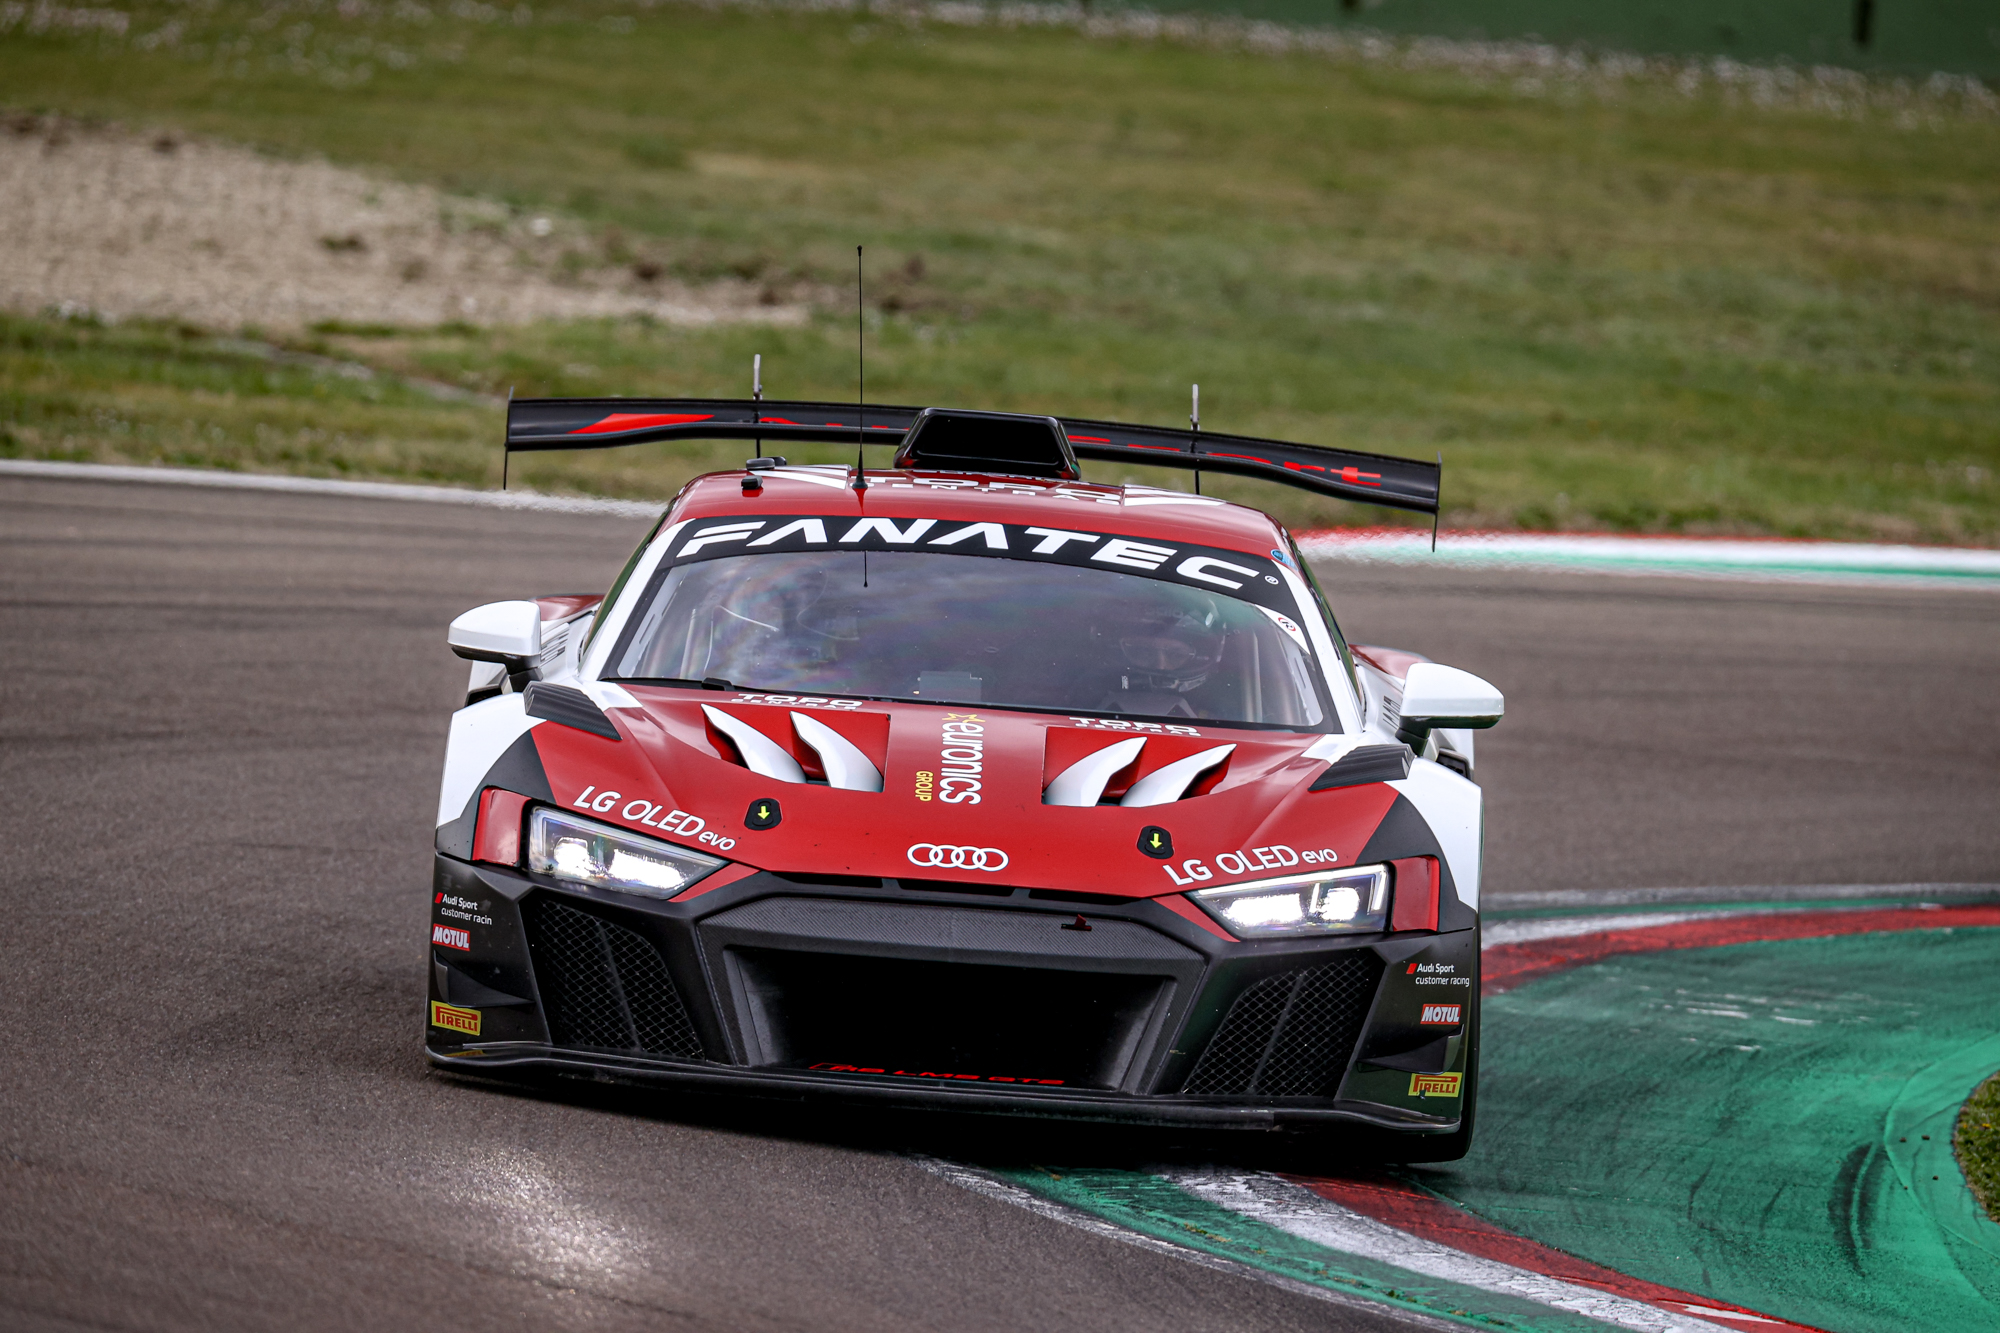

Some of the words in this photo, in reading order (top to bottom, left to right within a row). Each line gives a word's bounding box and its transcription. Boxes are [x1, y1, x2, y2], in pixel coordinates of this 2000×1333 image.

[738, 693, 863, 707] TOPO
[939, 722, 985, 805] euronics
[915, 770, 934, 802] GROUP
[573, 785, 622, 813] LG
[622, 799, 706, 837] OLED
[698, 831, 736, 851] evo
[1162, 859, 1214, 886] LG
[1215, 845, 1299, 875] OLED
[1301, 849, 1338, 864] evo
[442, 893, 459, 906] Audi
[458, 897, 479, 911] Sport
[441, 907, 473, 921] customer
[432, 926, 470, 949] MOTUL
[1416, 963, 1435, 973] Audi
[1435, 963, 1455, 975] Sport
[1415, 976, 1449, 986] customer
[1450, 977, 1470, 988] racing
[435, 1005, 478, 1033] PIRELLI
[1421, 1006, 1460, 1023] MOTUL
[1412, 1074, 1458, 1094] PIRELLI
